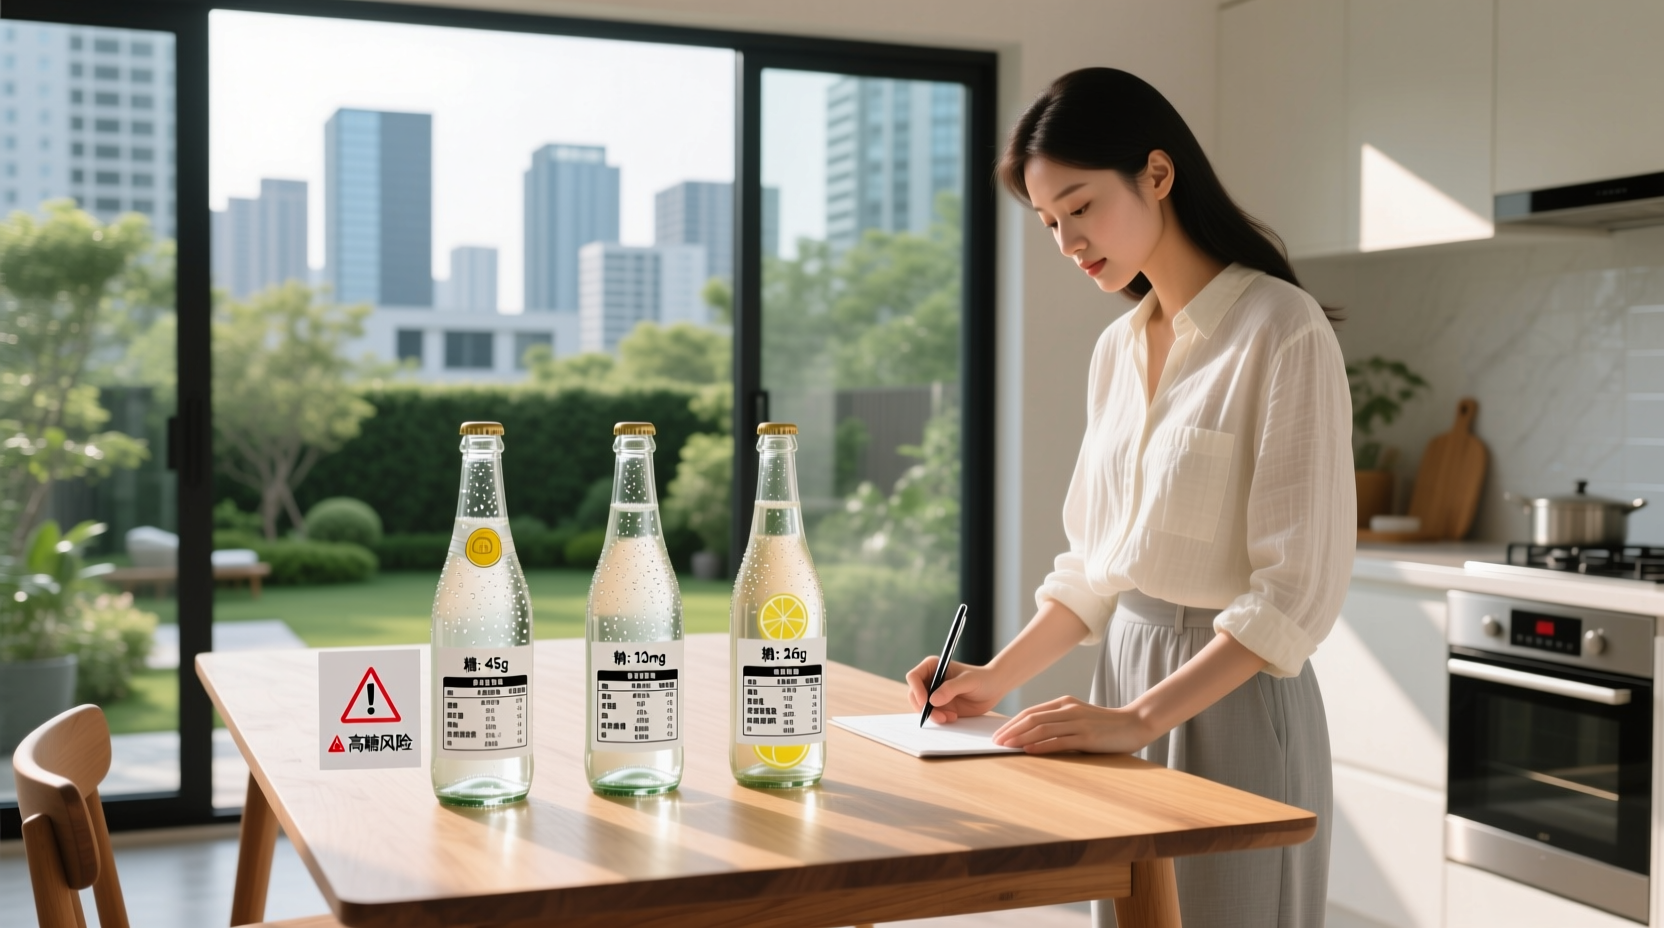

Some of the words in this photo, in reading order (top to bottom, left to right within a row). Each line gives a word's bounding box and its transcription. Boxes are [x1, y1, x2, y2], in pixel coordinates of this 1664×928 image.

[634, 650, 666, 666] 10mg
[784, 647, 807, 663] 26g
[485, 656, 509, 673] 45g
[348, 733, 413, 753] 高糖风险
